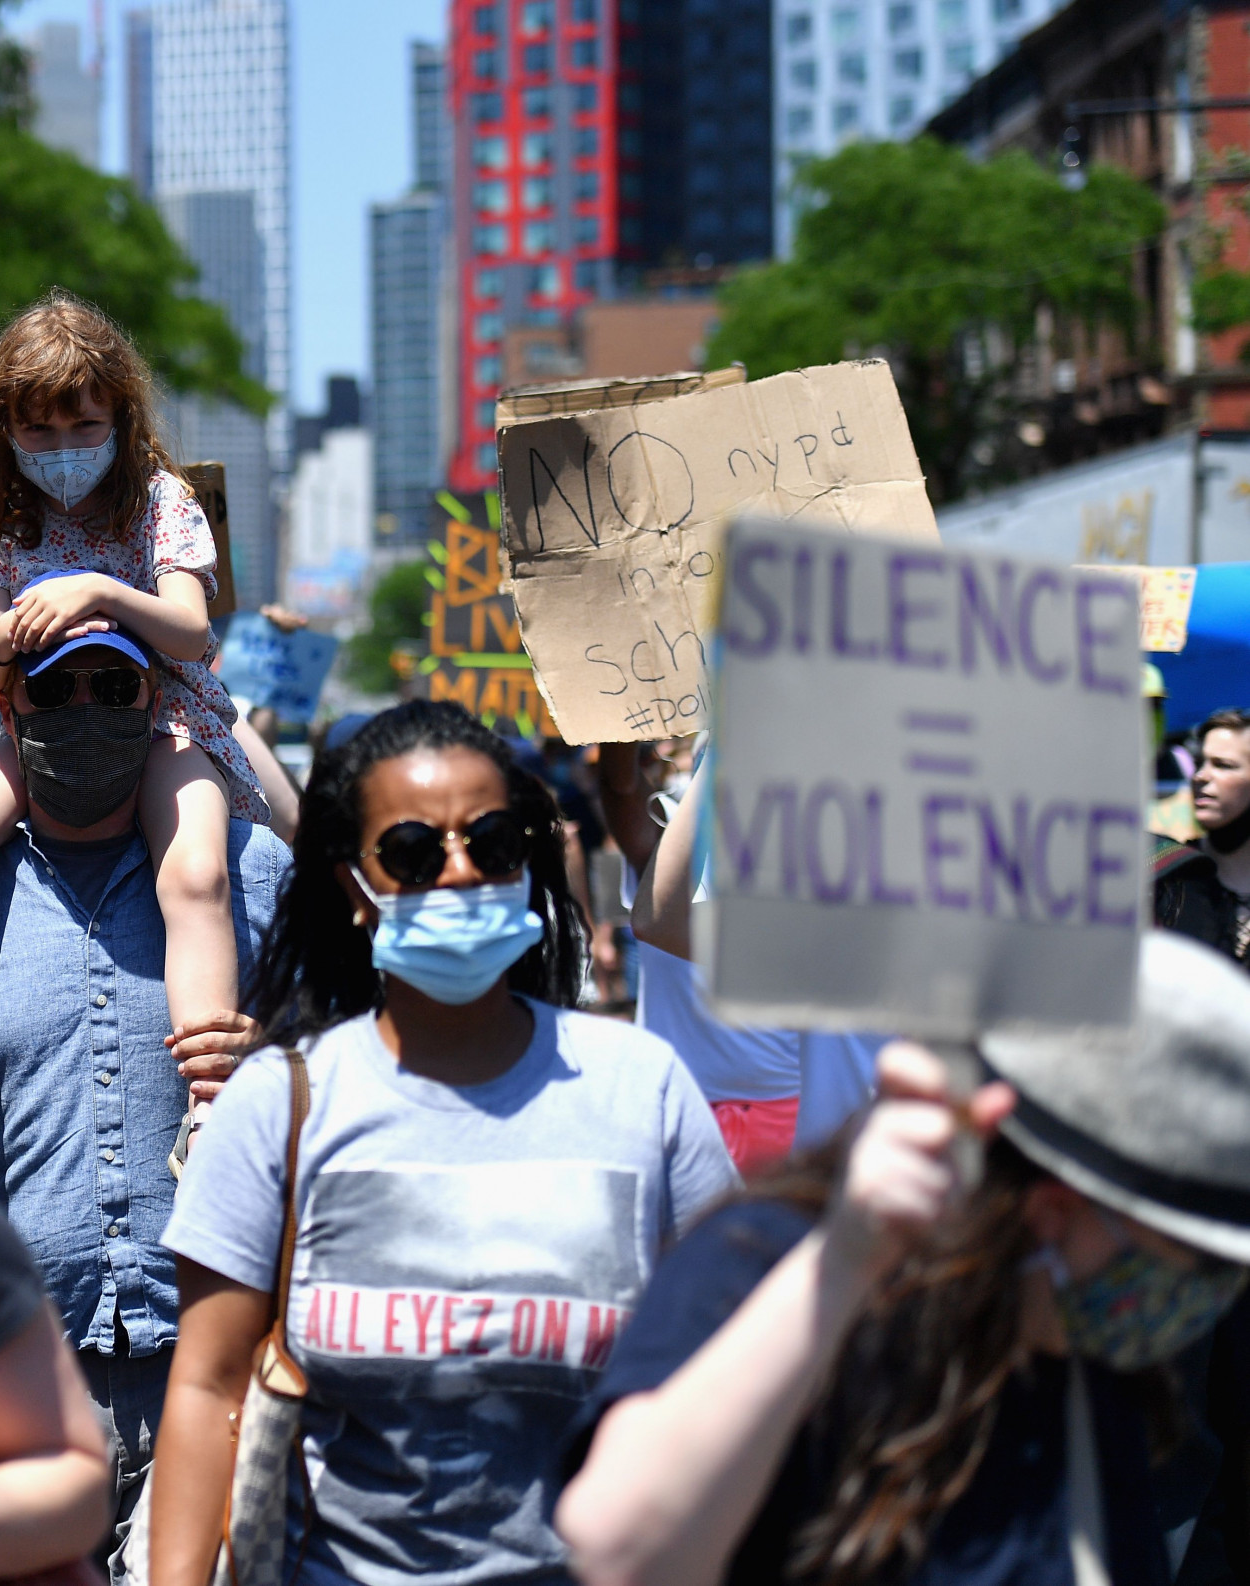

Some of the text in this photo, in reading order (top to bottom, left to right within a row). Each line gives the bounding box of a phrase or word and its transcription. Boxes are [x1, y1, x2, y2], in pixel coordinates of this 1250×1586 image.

[529, 410, 854, 552] NO nypd
[430, 592, 523, 658] LIV
[727, 541, 1140, 696] SILENCE
[717, 778, 1141, 927] VIOLENCE
[305, 1288, 634, 1368] ALL EYEZ ON M
